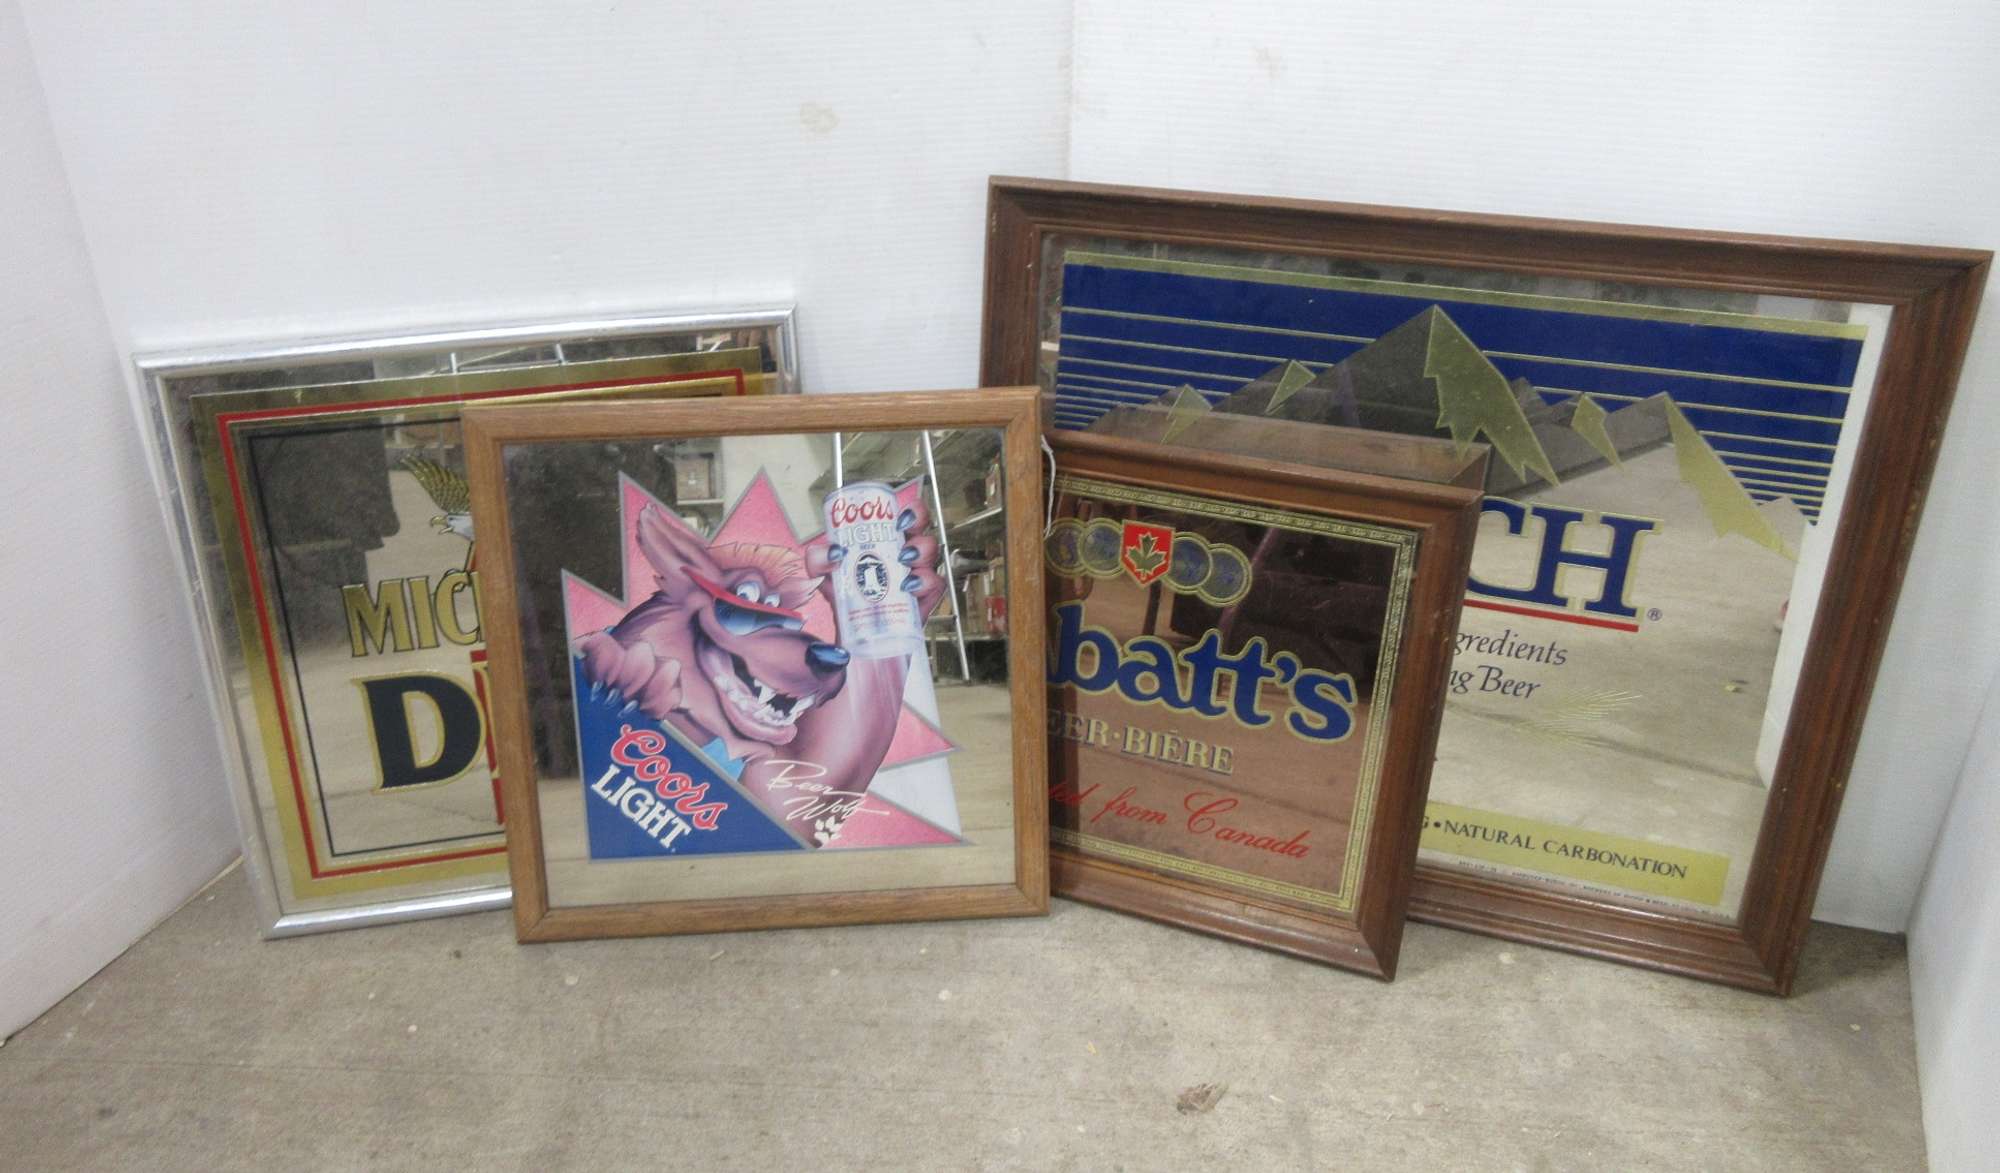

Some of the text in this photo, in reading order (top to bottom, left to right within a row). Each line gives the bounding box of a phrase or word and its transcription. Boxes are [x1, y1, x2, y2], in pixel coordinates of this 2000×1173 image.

[831, 496, 894, 528] Coors
[1046, 599, 1358, 743] batt's
[1477, 664, 1541, 699] Beer
[610, 723, 728, 831] Coors
[590, 763, 692, 849] LIGHT
[783, 796, 890, 822] Wolf
[1090, 786, 1168, 824] from
[1183, 791, 1312, 859] Canada
[1543, 839, 1687, 880] CARBONATION
